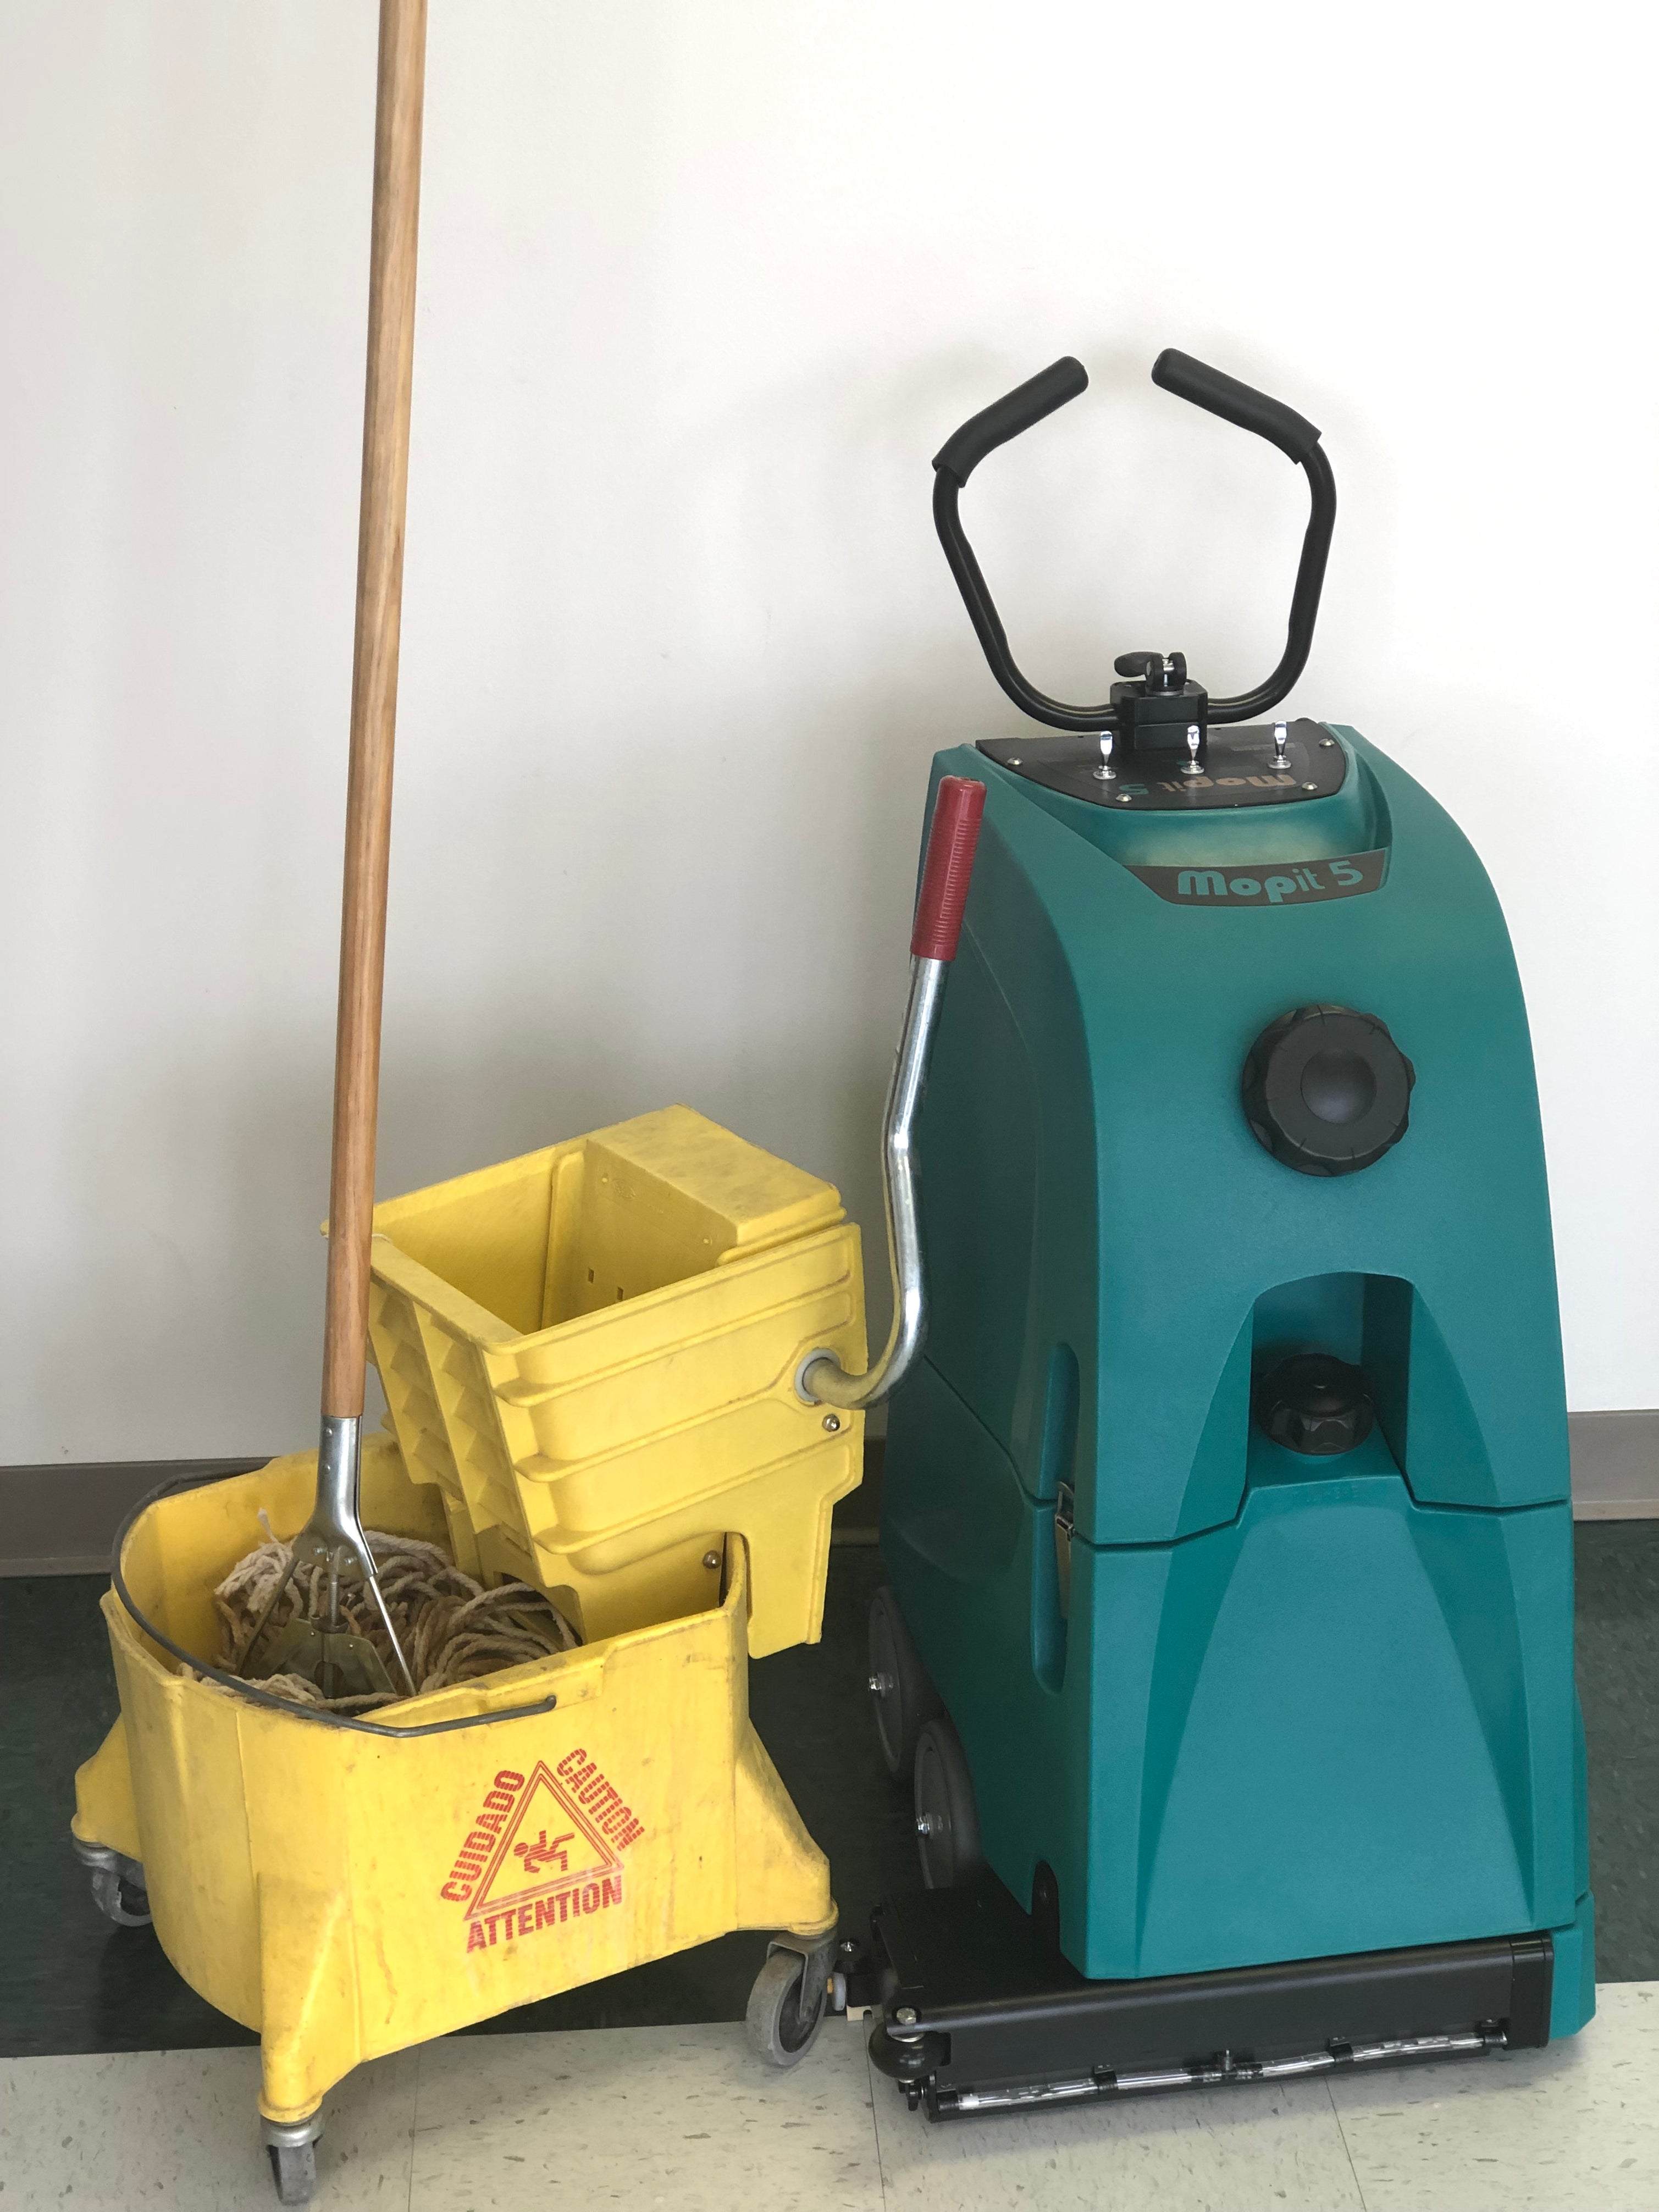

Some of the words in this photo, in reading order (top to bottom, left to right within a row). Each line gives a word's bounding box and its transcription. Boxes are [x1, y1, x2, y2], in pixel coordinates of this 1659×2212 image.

[1118, 783, 1149, 796] 5
[1328, 860, 1363, 886] 5
[440, 1770, 525, 1902] CUIDADO
[556, 1748, 645, 1852] CAUTION
[466, 1874, 622, 1954] ATTENTION
